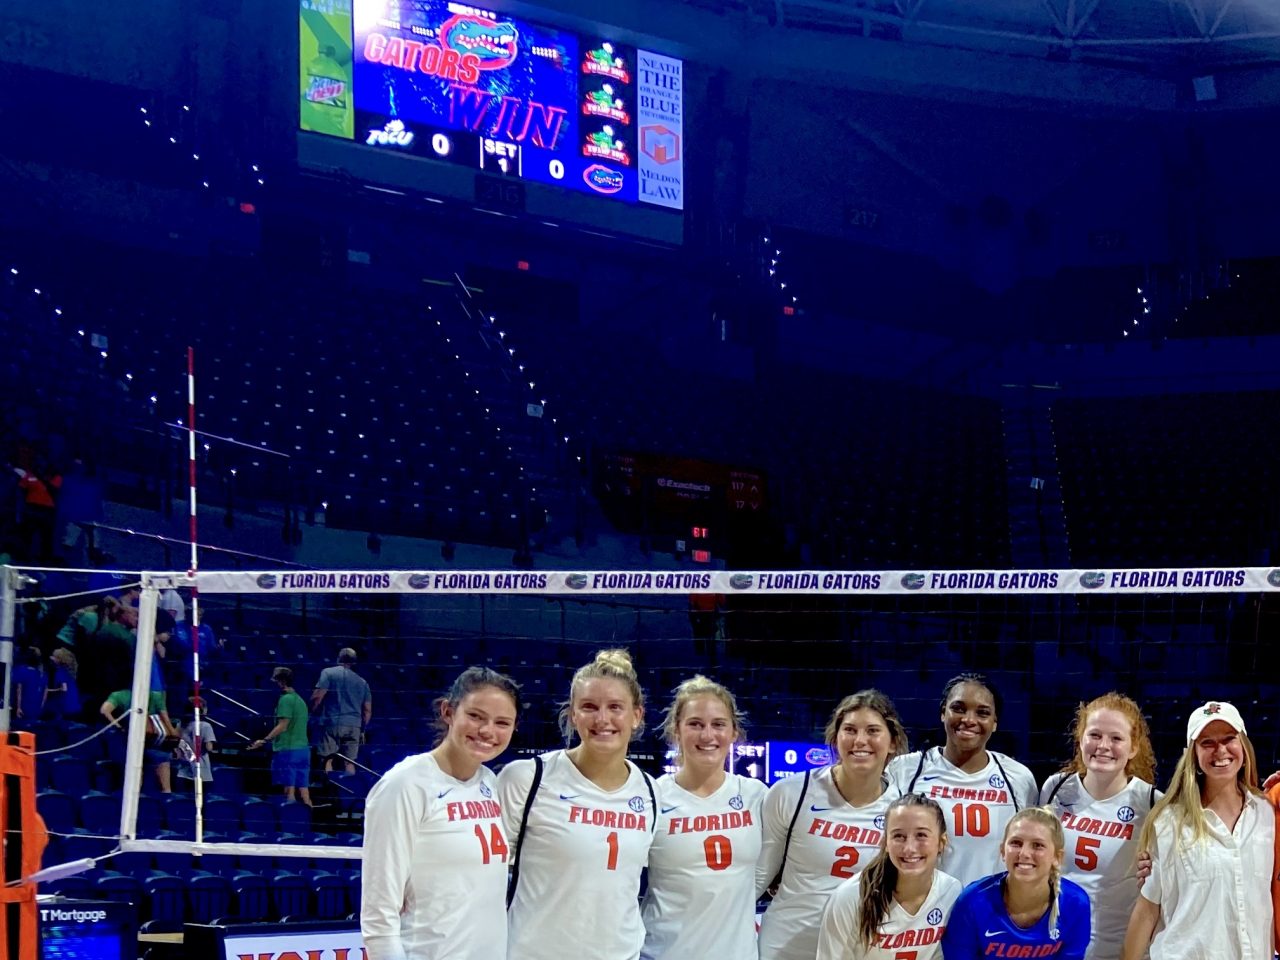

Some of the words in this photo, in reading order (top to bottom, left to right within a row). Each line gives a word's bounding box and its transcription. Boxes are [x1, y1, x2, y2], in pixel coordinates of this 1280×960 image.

[364, 32, 481, 84] GATORS
[640, 69, 680, 92] THE
[640, 95, 681, 116] BLUE
[450, 83, 568, 150] WIN
[432, 133, 450, 155] 0
[484, 139, 517, 158] SET
[497, 158, 509, 172] 1
[549, 159, 565, 179] 0
[640, 168, 681, 185] MELDON
[641, 179, 681, 201] LAW
[281, 573, 336, 589] FLORIDA
[338, 573, 390, 589] GATORS
[433, 573, 490, 590] FLORIDA
[493, 573, 547, 590] GATORS
[592, 573, 652, 589] FLORIDA
[655, 573, 711, 589] GATORS
[757, 573, 819, 590] FLORIDA
[822, 573, 881, 590] GATORS
[930, 572, 995, 589] FLORIDA
[998, 572, 1059, 589] GATORS
[1110, 570, 1178, 588] FLORIDA
[1181, 570, 1246, 588] GATORS
[736, 745, 765, 757] SET
[785, 749, 798, 765] 0
[931, 785, 1008, 804] FLORIDA
[568, 806, 646, 832] FLORIDA
[668, 810, 753, 836] FLORIDA
[952, 803, 991, 838] 10
[1060, 811, 1135, 841] FLORIDA
[808, 817, 882, 846] FLORID
[474, 823, 508, 865] 14
[606, 831, 619, 871] 1
[703, 834, 732, 871] 0
[1074, 836, 1102, 872] 5
[830, 846, 859, 880] 2
[51, 909, 106, 922] Mortgage
[985, 940, 1064, 958] FLORIDA
